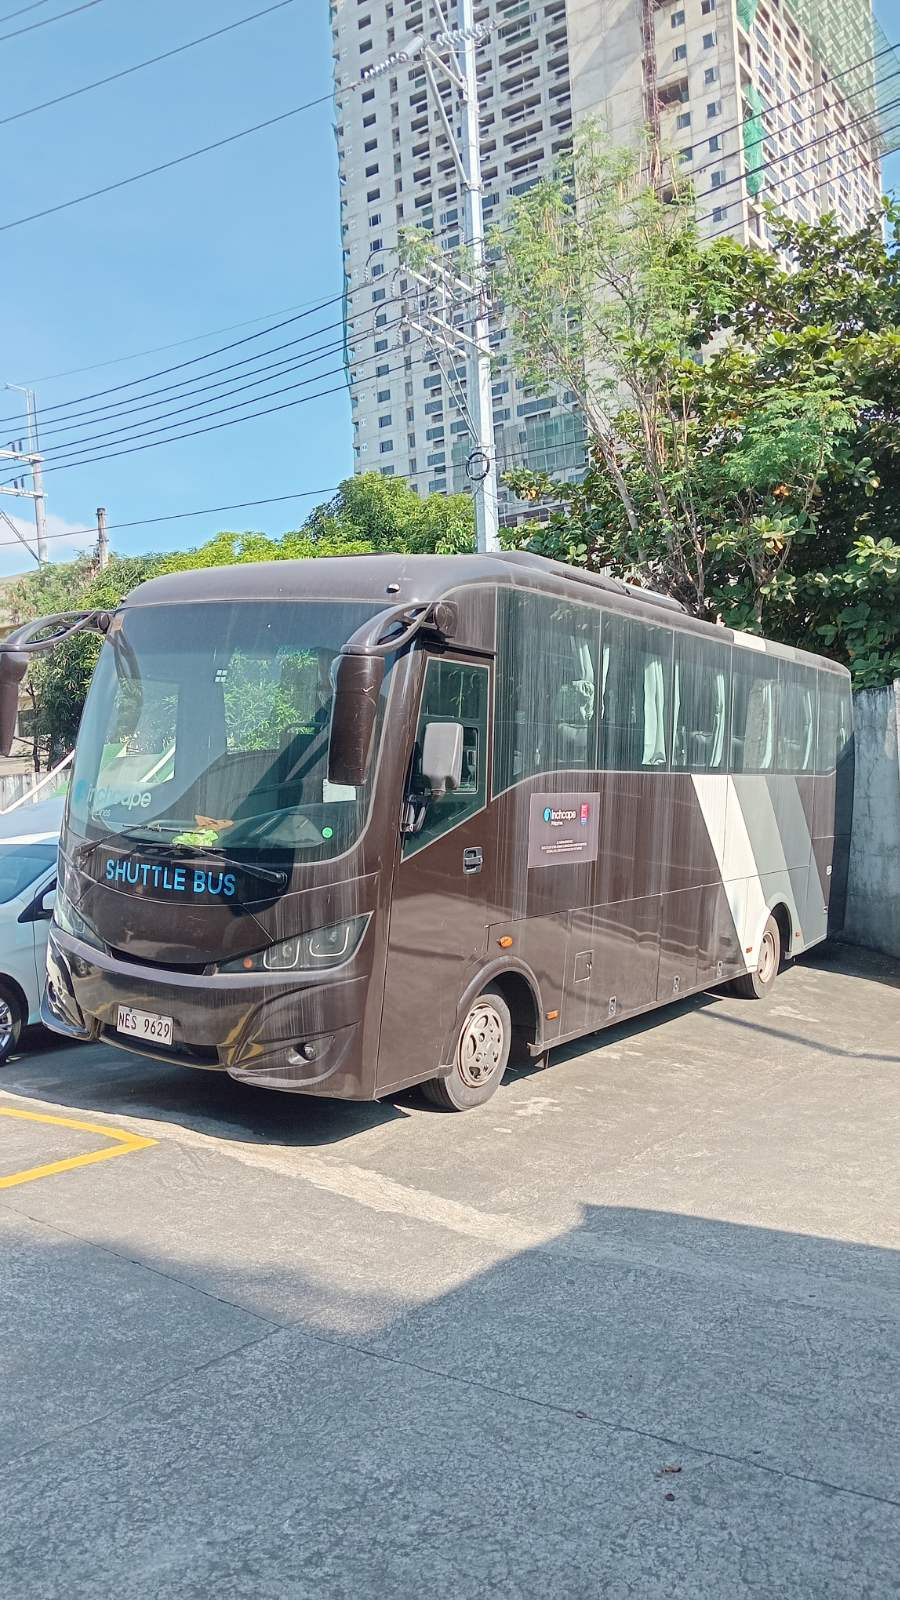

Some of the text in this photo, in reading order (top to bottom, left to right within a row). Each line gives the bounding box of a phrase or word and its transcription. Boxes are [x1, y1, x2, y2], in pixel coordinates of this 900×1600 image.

[106, 859, 236, 896] SHUTTLE BUS
[119, 1012, 170, 1038] NES 9629
